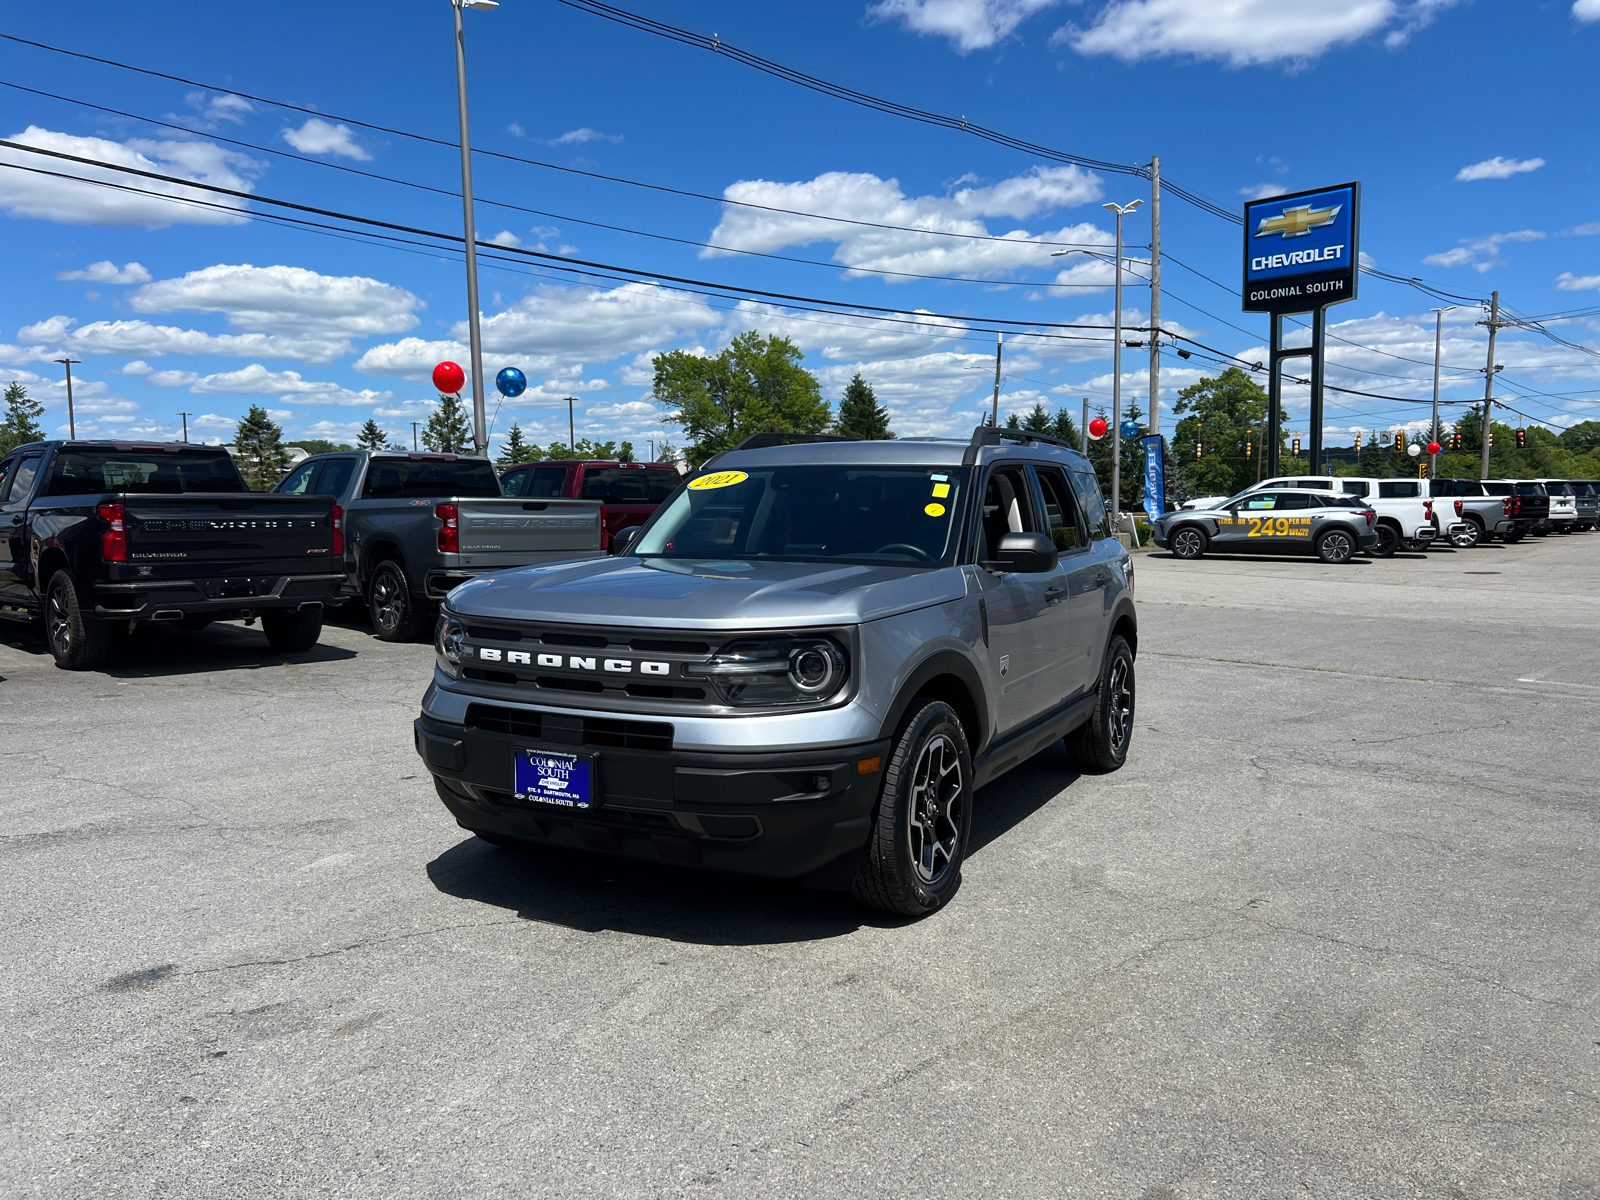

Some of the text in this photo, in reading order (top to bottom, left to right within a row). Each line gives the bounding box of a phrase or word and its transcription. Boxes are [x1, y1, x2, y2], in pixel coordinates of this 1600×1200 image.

[1251, 244, 1344, 271] CHEVROLET
[1250, 280, 1343, 301] COLONIAL SOUTH
[694, 474, 741, 488] 2021
[471, 518, 596, 528] CHEVROLET
[479, 647, 670, 676] BRONCO
[530, 756, 576, 770] COLONIAL
[537, 766, 569, 779] SOUTH
[541, 779, 565, 787] CHEVROLET
[528, 795, 574, 807] COLONIAL SOUTH
